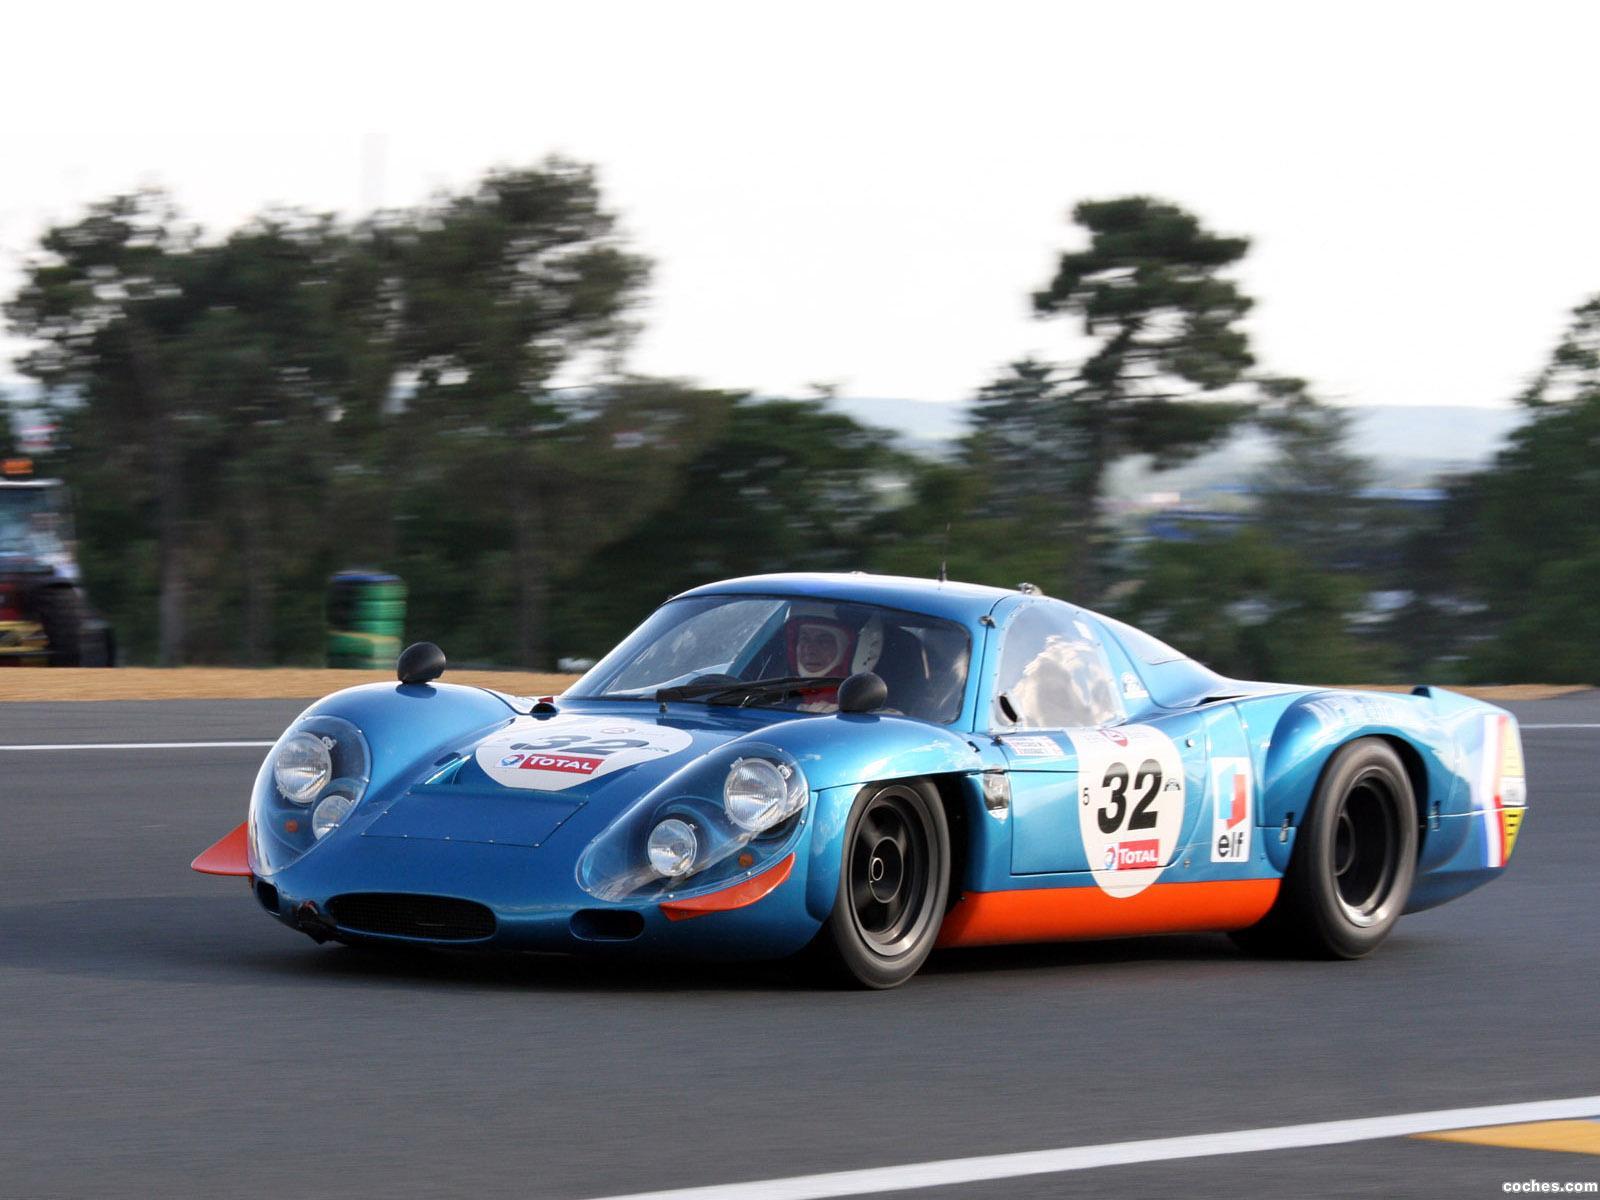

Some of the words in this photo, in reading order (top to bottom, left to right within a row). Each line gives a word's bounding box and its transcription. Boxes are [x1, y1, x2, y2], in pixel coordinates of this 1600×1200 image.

[529, 756, 593, 770] TOTAL
[1097, 758, 1163, 835] 32
[1218, 831, 1244, 858] elf
[1118, 848, 1159, 865] TOTAL
